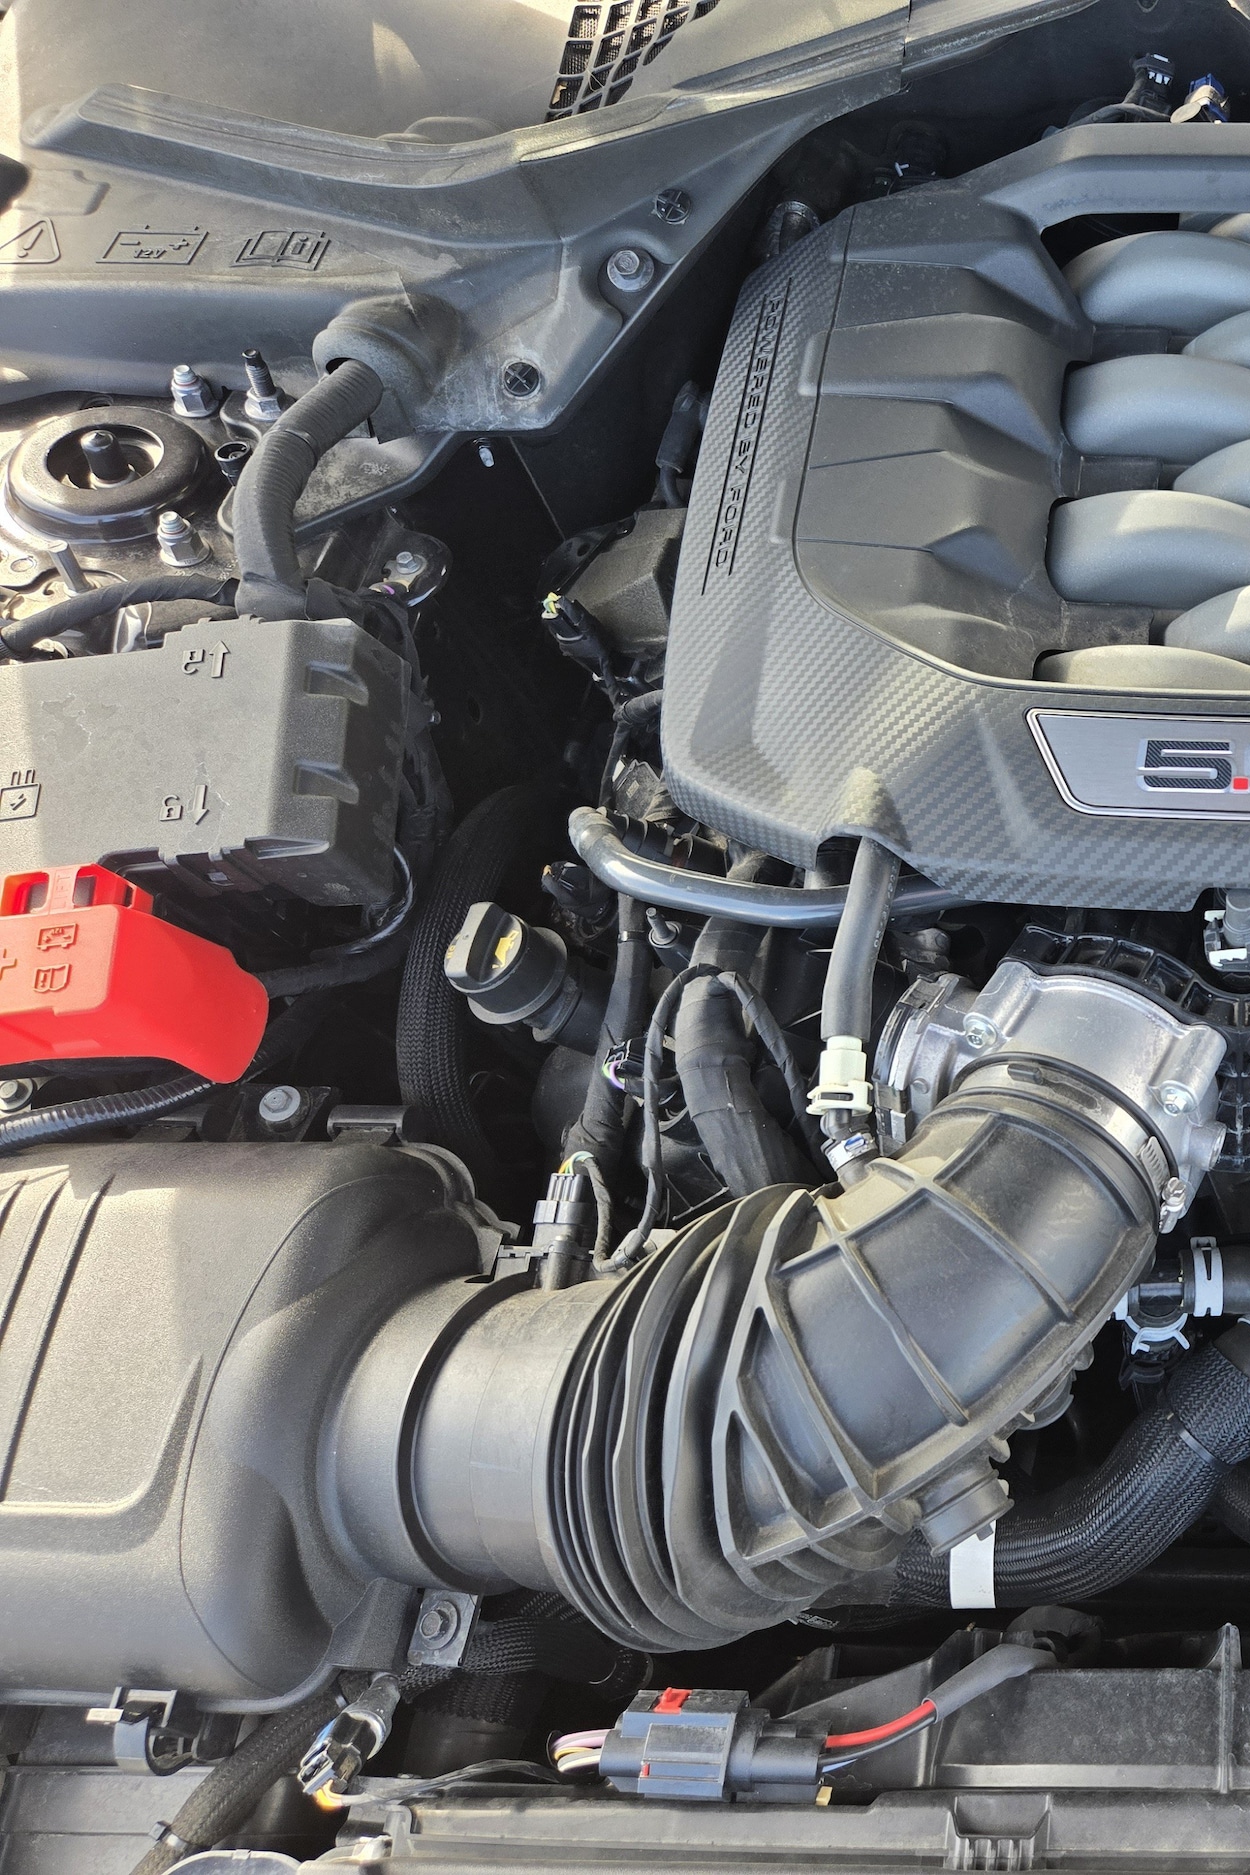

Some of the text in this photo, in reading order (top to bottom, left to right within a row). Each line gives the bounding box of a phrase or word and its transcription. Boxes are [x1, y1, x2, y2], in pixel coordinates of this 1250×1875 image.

[134, 249, 167, 259] 12V
[715, 295, 783, 568] POWERED BY FORD
